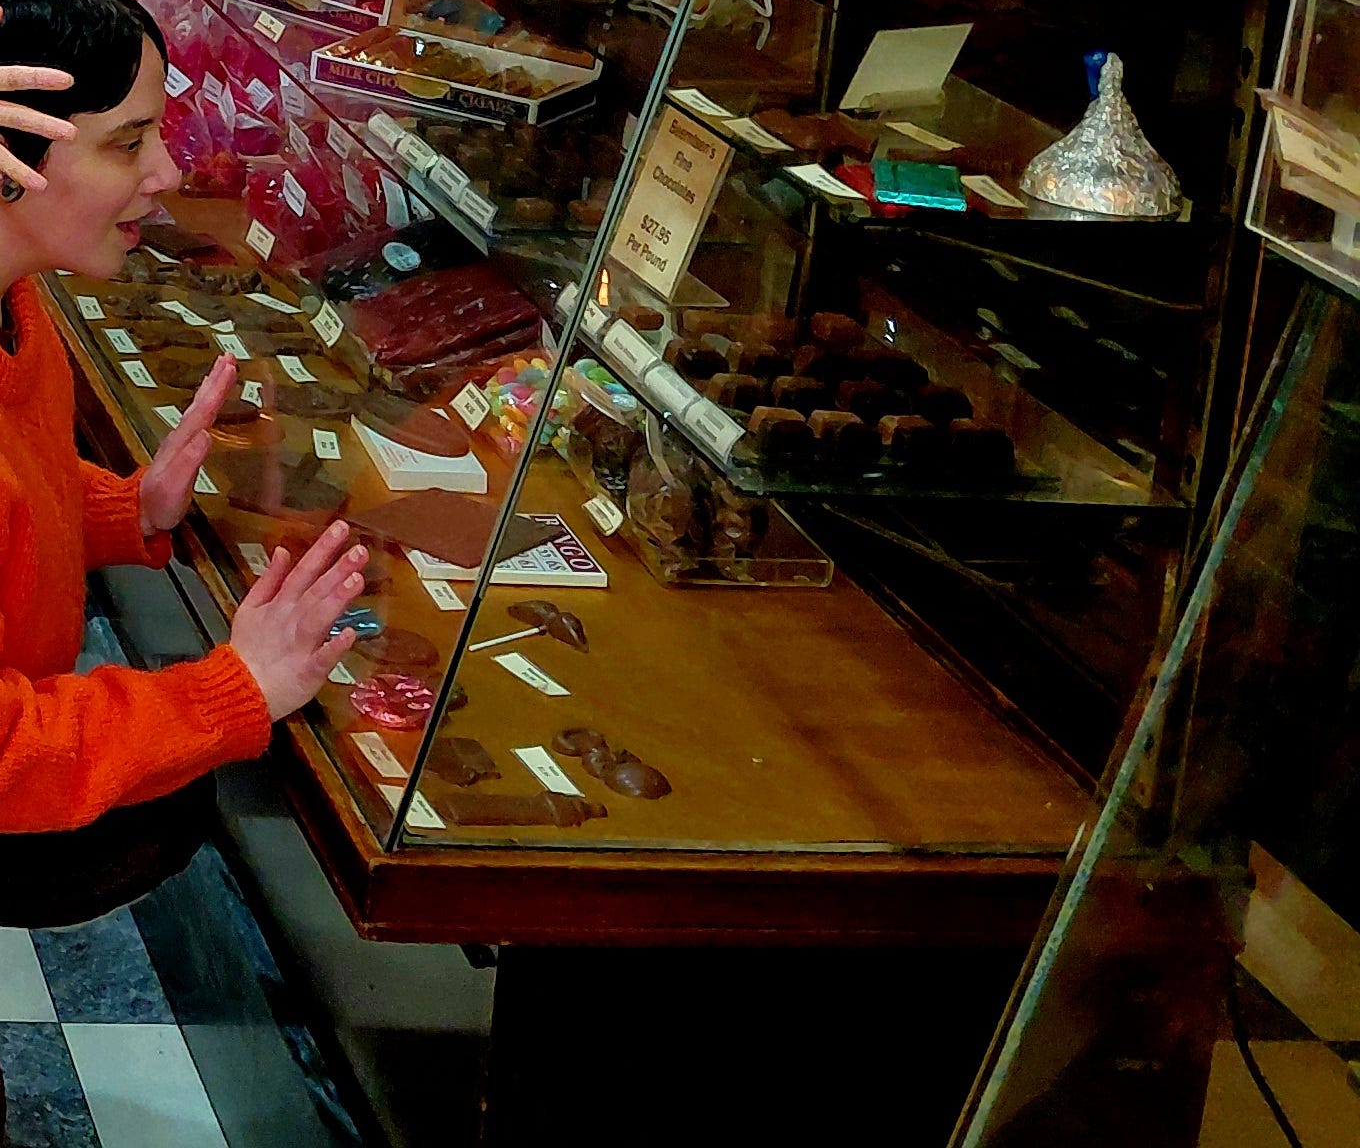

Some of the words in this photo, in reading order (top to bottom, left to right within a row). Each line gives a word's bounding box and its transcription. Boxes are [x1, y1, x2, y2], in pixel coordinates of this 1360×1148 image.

[329, 63, 362, 82] MILK
[652, 165, 696, 205] Chocolates
[640, 213, 672, 246] $27.95
[625, 233, 642, 254] Per
[642, 243, 670, 273] Pound
